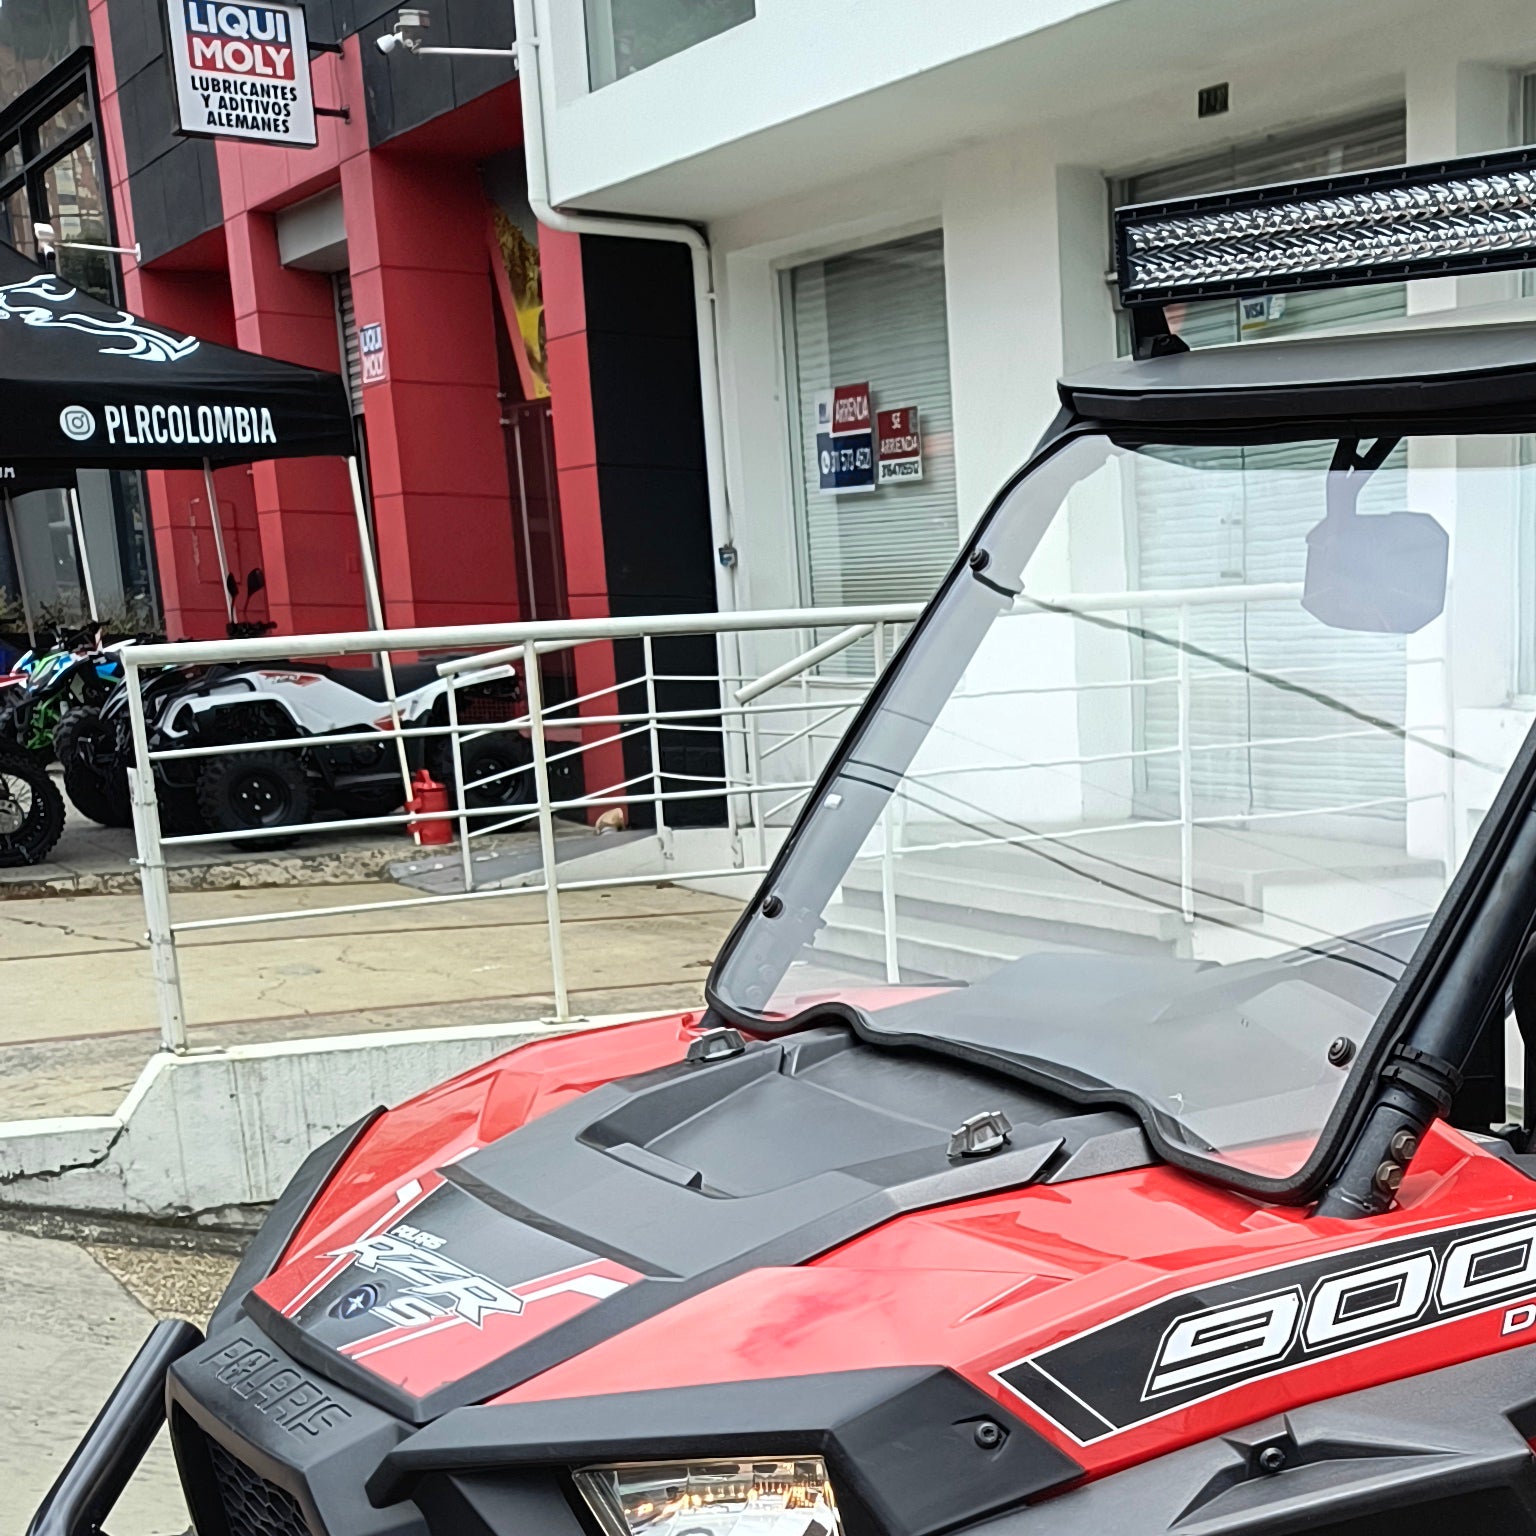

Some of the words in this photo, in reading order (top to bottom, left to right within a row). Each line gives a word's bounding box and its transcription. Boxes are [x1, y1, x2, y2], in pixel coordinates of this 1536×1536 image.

[188, 1, 286, 42] LIQUI
[193, 37, 290, 76] MOLY
[191, 75, 297, 101] LUBRICANTES
[201, 93, 210, 108] Y
[218, 97, 291, 117] ADITIVOS
[207, 111, 290, 134] ALEMANES
[104, 404, 277, 444] PLRCOLOMBIA
[391, 1224, 448, 1250] POLARIS
[324, 1234, 525, 1330] RZR
[199, 1337, 353, 1437] POLARIS
